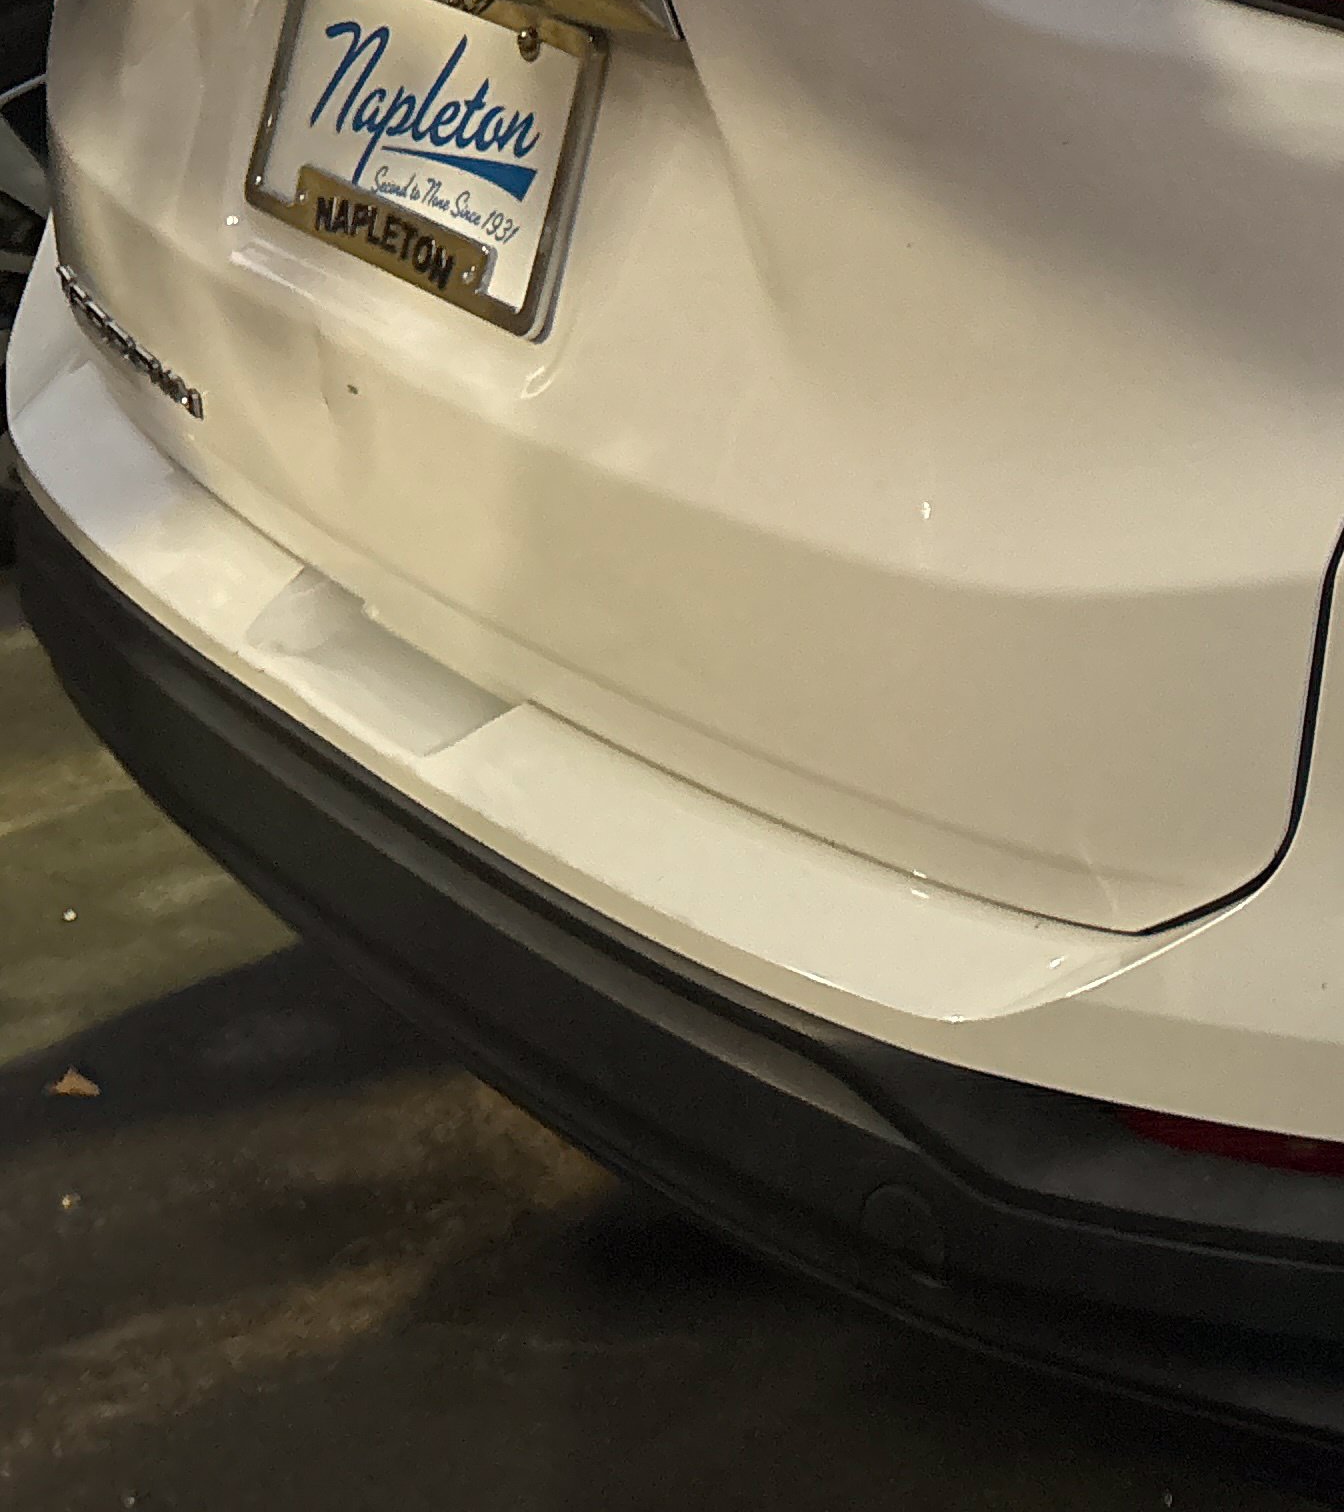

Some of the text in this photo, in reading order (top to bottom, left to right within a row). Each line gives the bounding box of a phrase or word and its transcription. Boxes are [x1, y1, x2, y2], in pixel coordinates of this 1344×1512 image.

[310, 20, 541, 186] Napleton
[315, 196, 457, 291] NAPLETON
[371, 165, 416, 199] Second
[421, 177, 452, 211] None
[450, 190, 482, 226] Since
[481, 209, 520, 244] 1931
